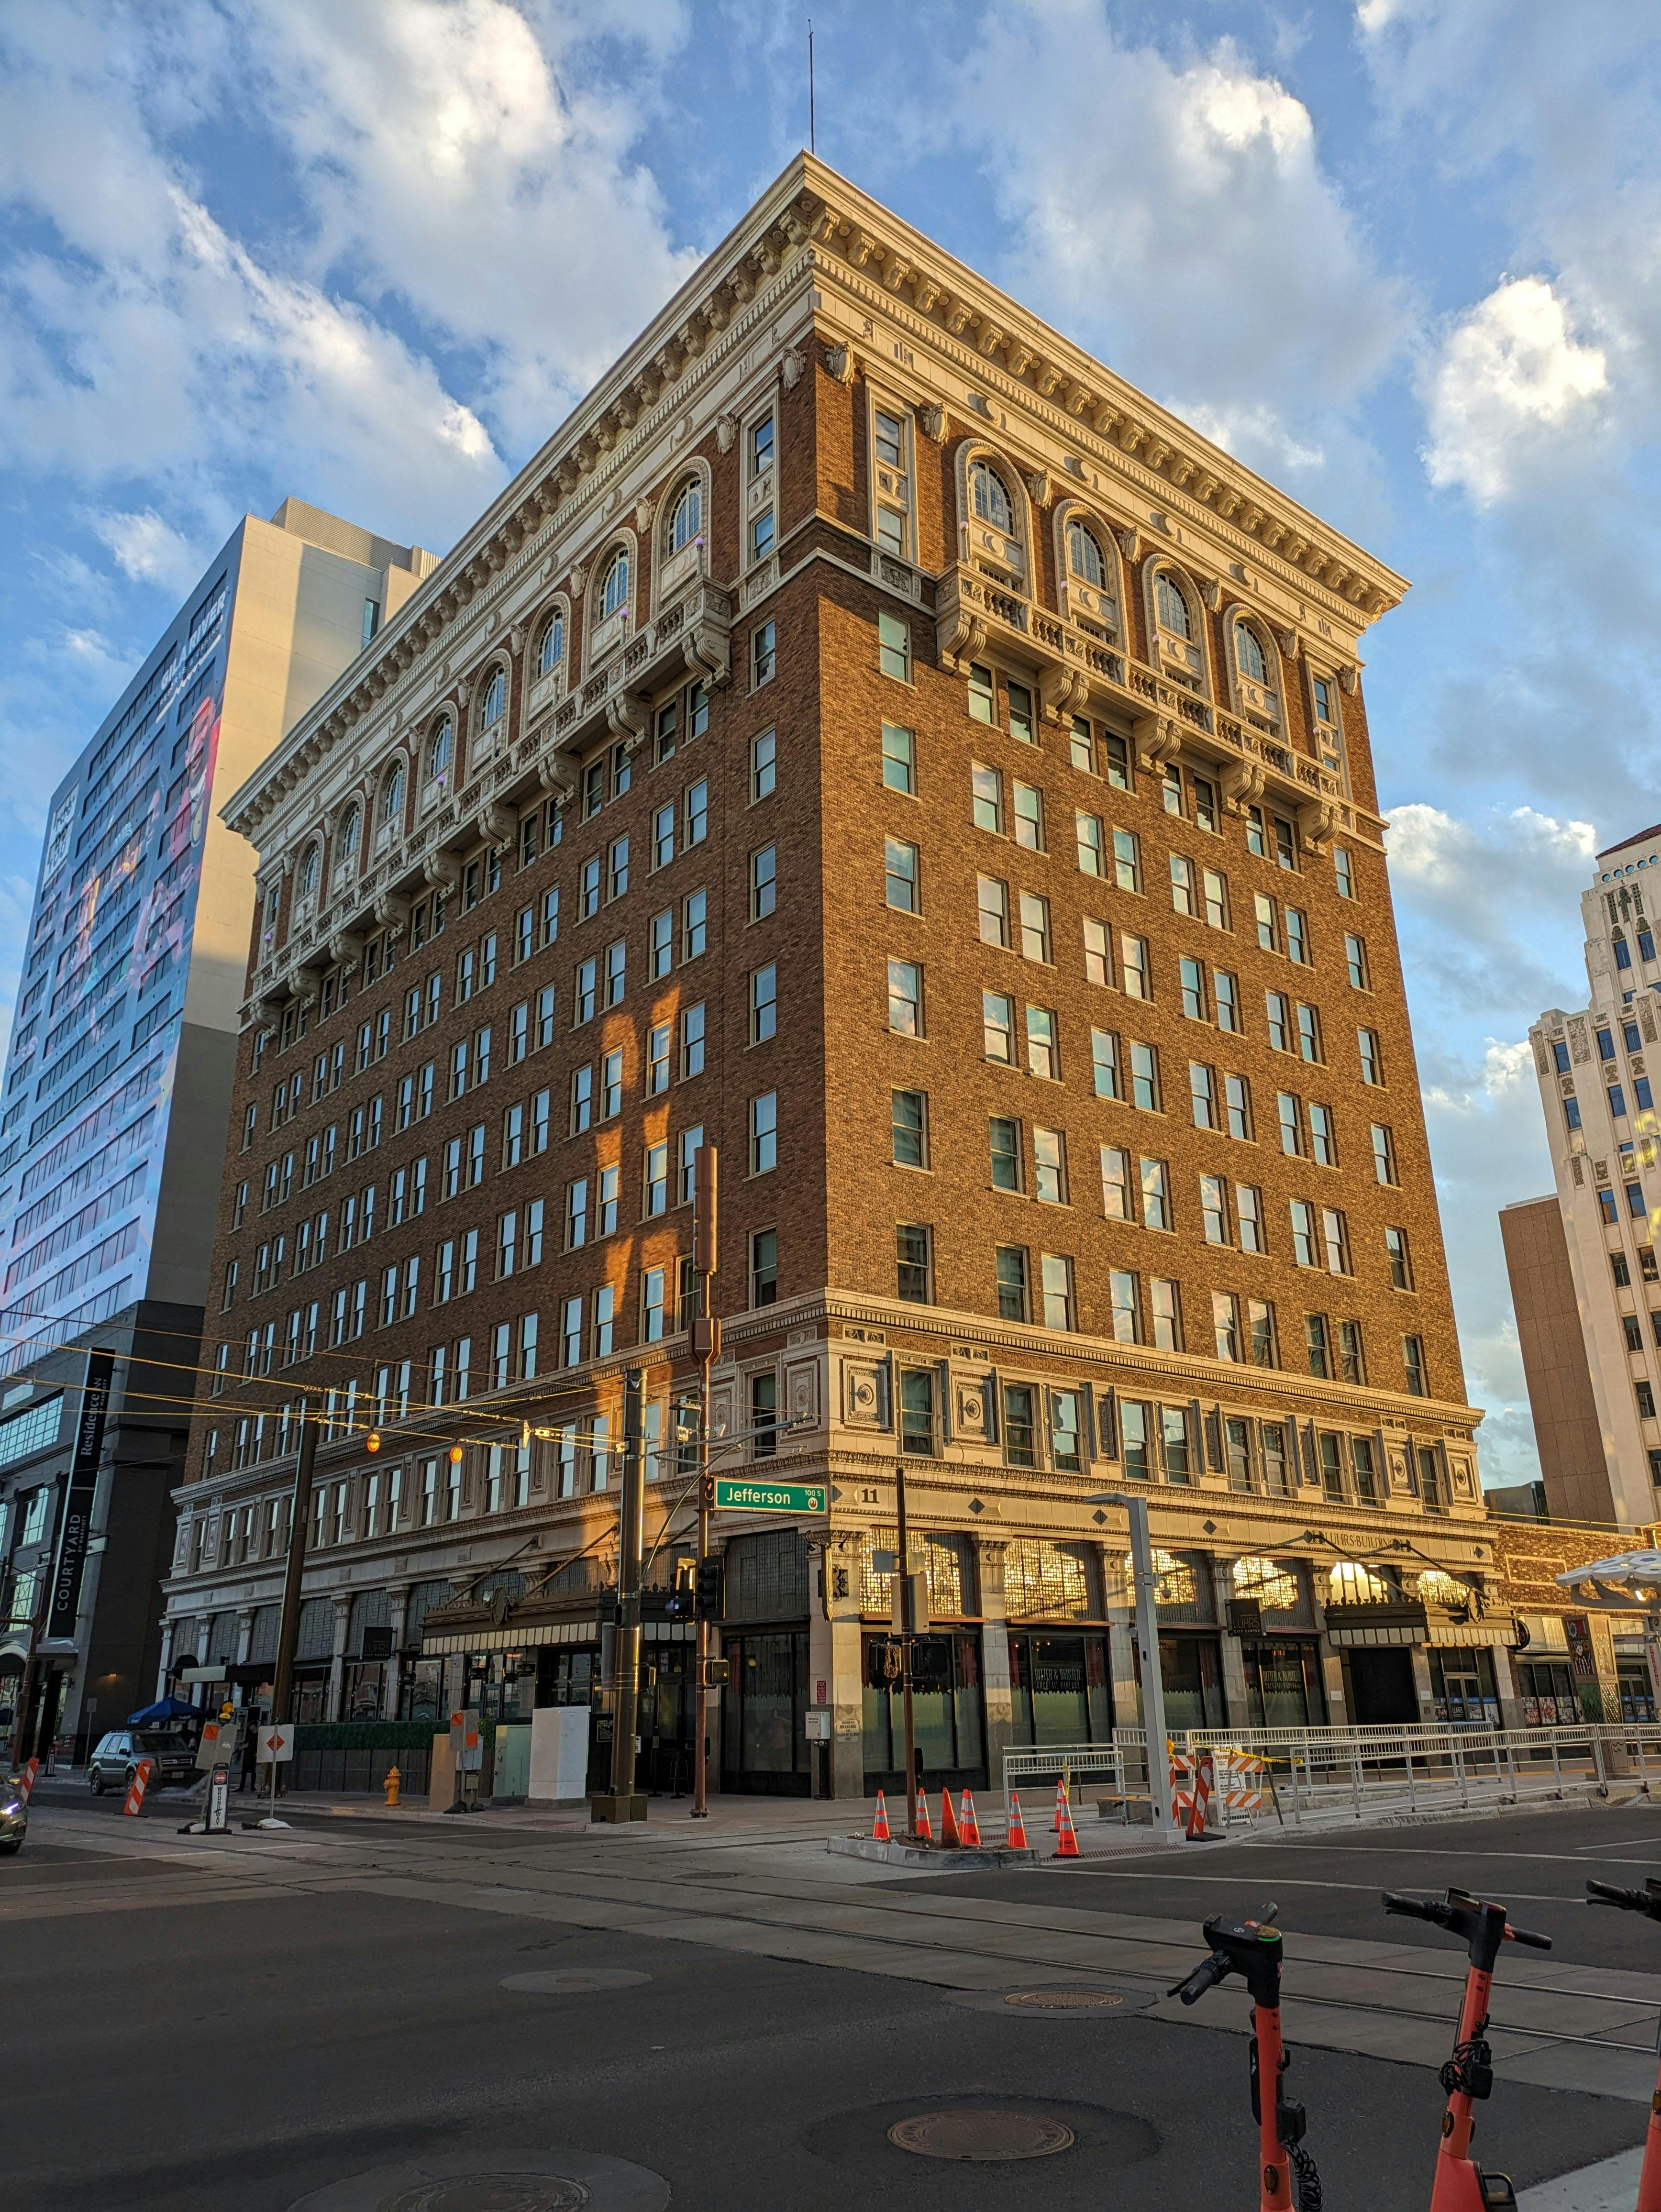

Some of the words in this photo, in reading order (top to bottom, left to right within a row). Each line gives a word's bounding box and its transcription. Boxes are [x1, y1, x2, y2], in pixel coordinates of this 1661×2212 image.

[161, 645, 187, 690] GILA
[188, 590, 226, 654] RIVER
[100, 1379, 108, 1406] MARROTT
[80, 1394, 100, 1456] Residence
[726, 1487, 790, 1504] Jefferson
[861, 1488, 880, 1504] 11
[79, 1515, 88, 1544] MARRIOTT
[57, 1515, 81, 1611] COURTYARD
[1233, 1617, 1259, 1629] LUHRS
[365, 1642, 390, 1653] LUHRS
[1035, 1668, 1053, 1681] BITTER
[1060, 1668, 1081, 1681] TWISTED
[1649, 1645, 1660, 1688] EMERGENCY
